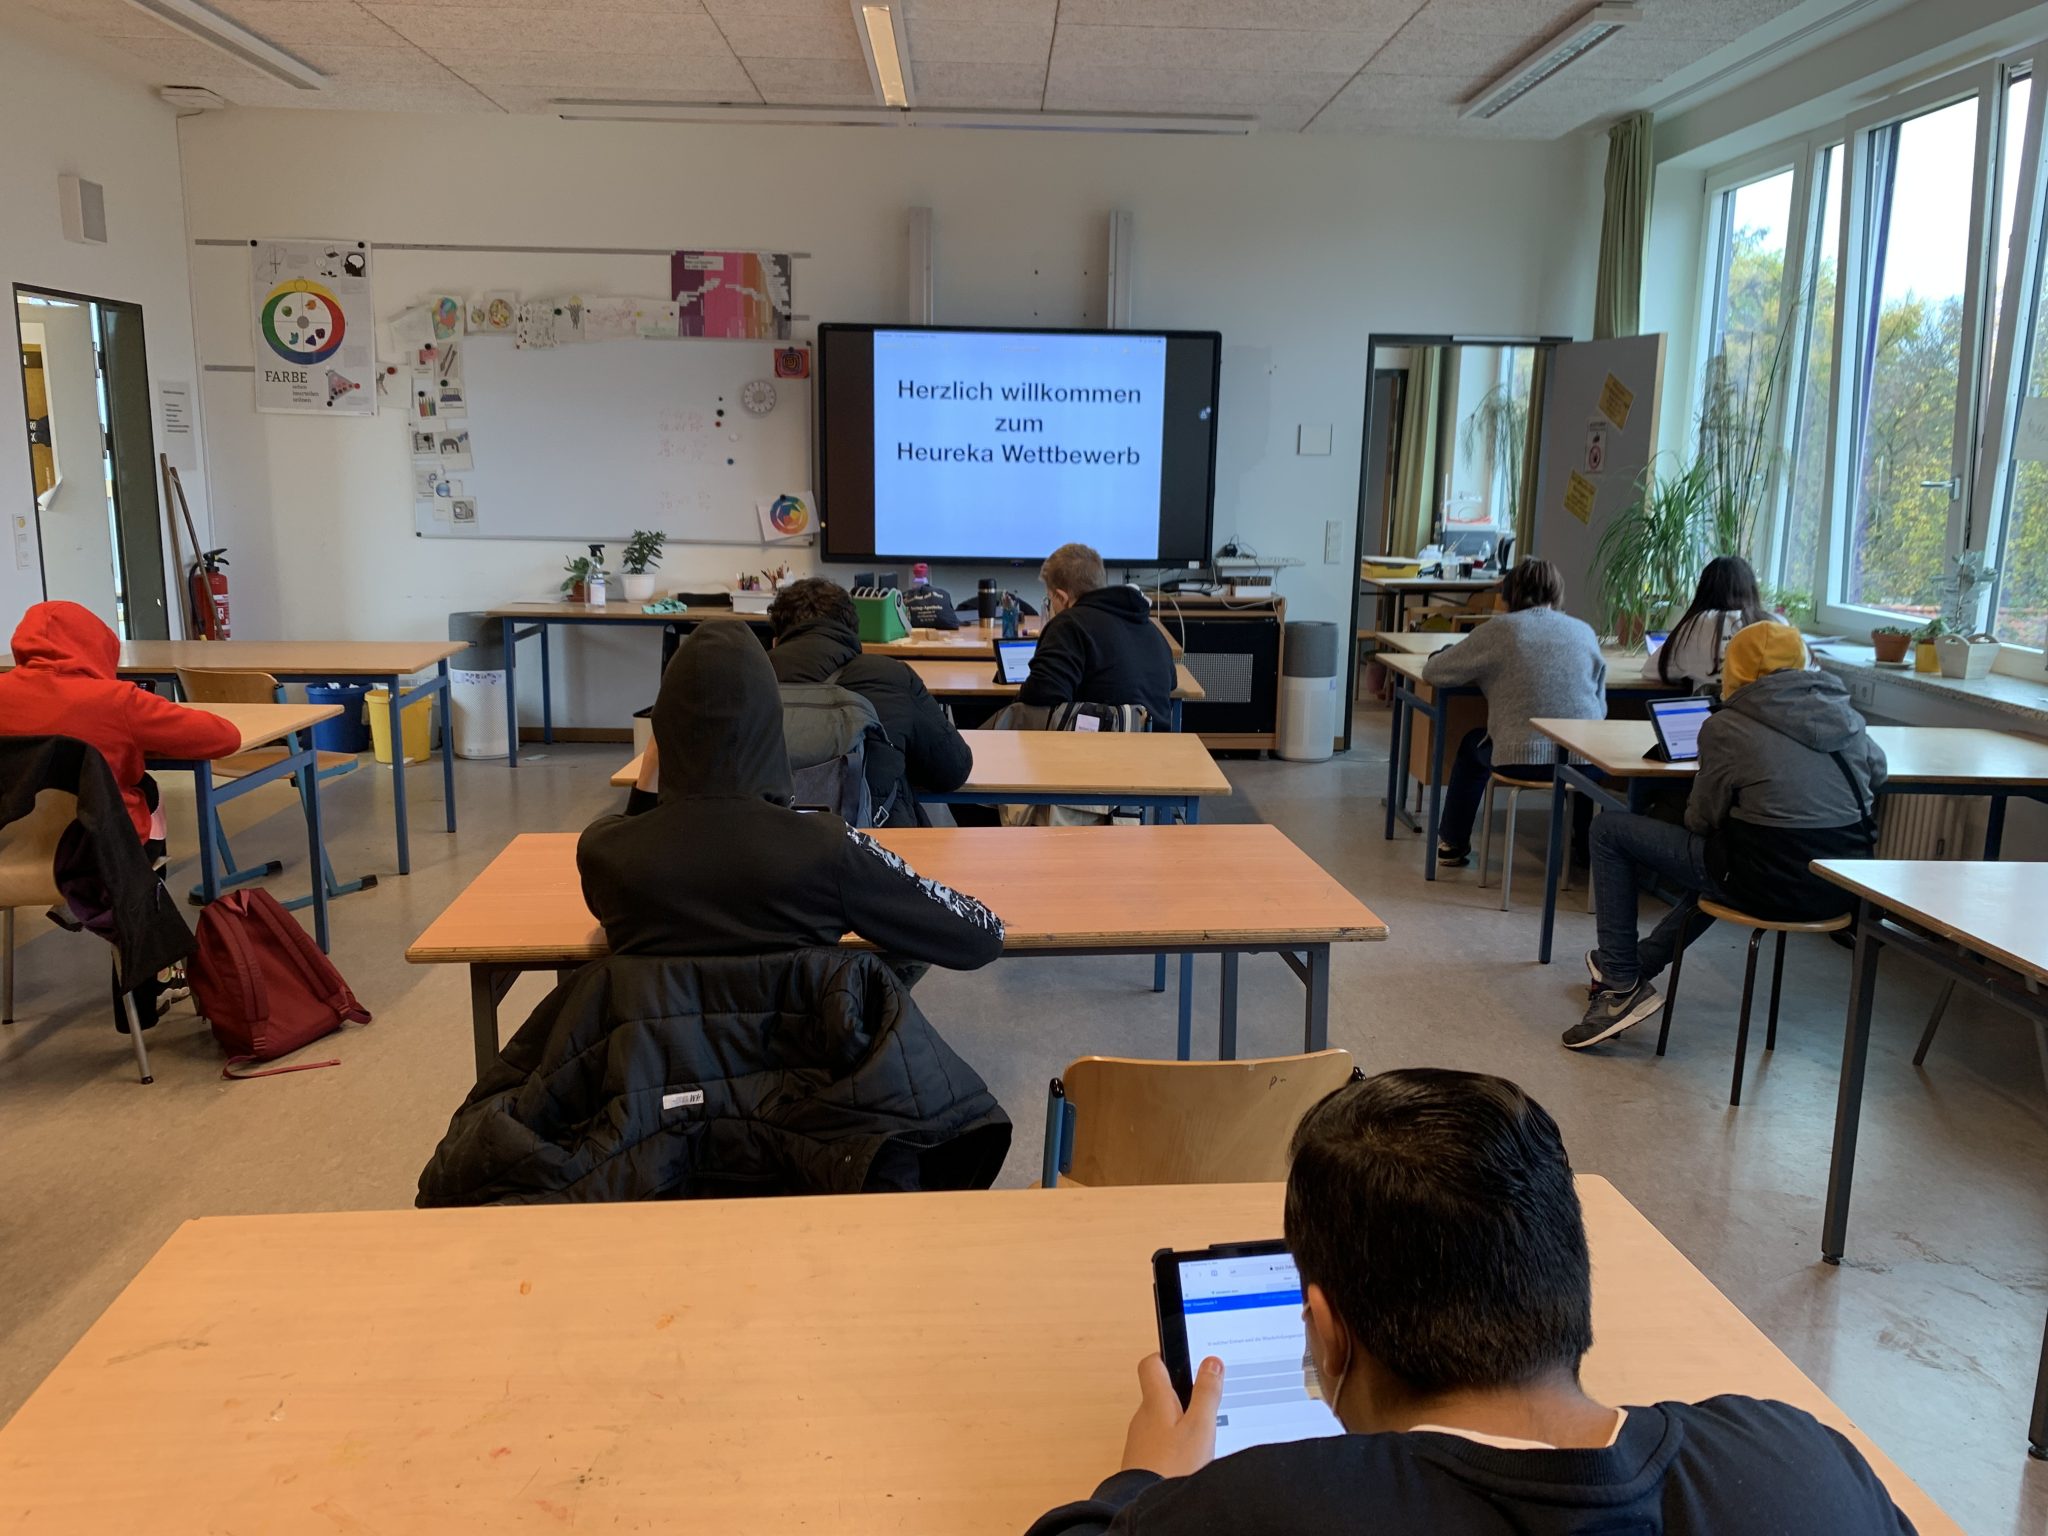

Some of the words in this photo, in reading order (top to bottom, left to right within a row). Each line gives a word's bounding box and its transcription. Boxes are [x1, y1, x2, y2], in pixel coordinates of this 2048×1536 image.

[265, 370, 308, 384] FARBE
[898, 379, 993, 401] Herzlich
[1000, 382, 1141, 404] willkommen
[994, 417, 1043, 433] zum
[897, 442, 993, 463] Heureka
[1001, 444, 1140, 466] Wettbewerb
